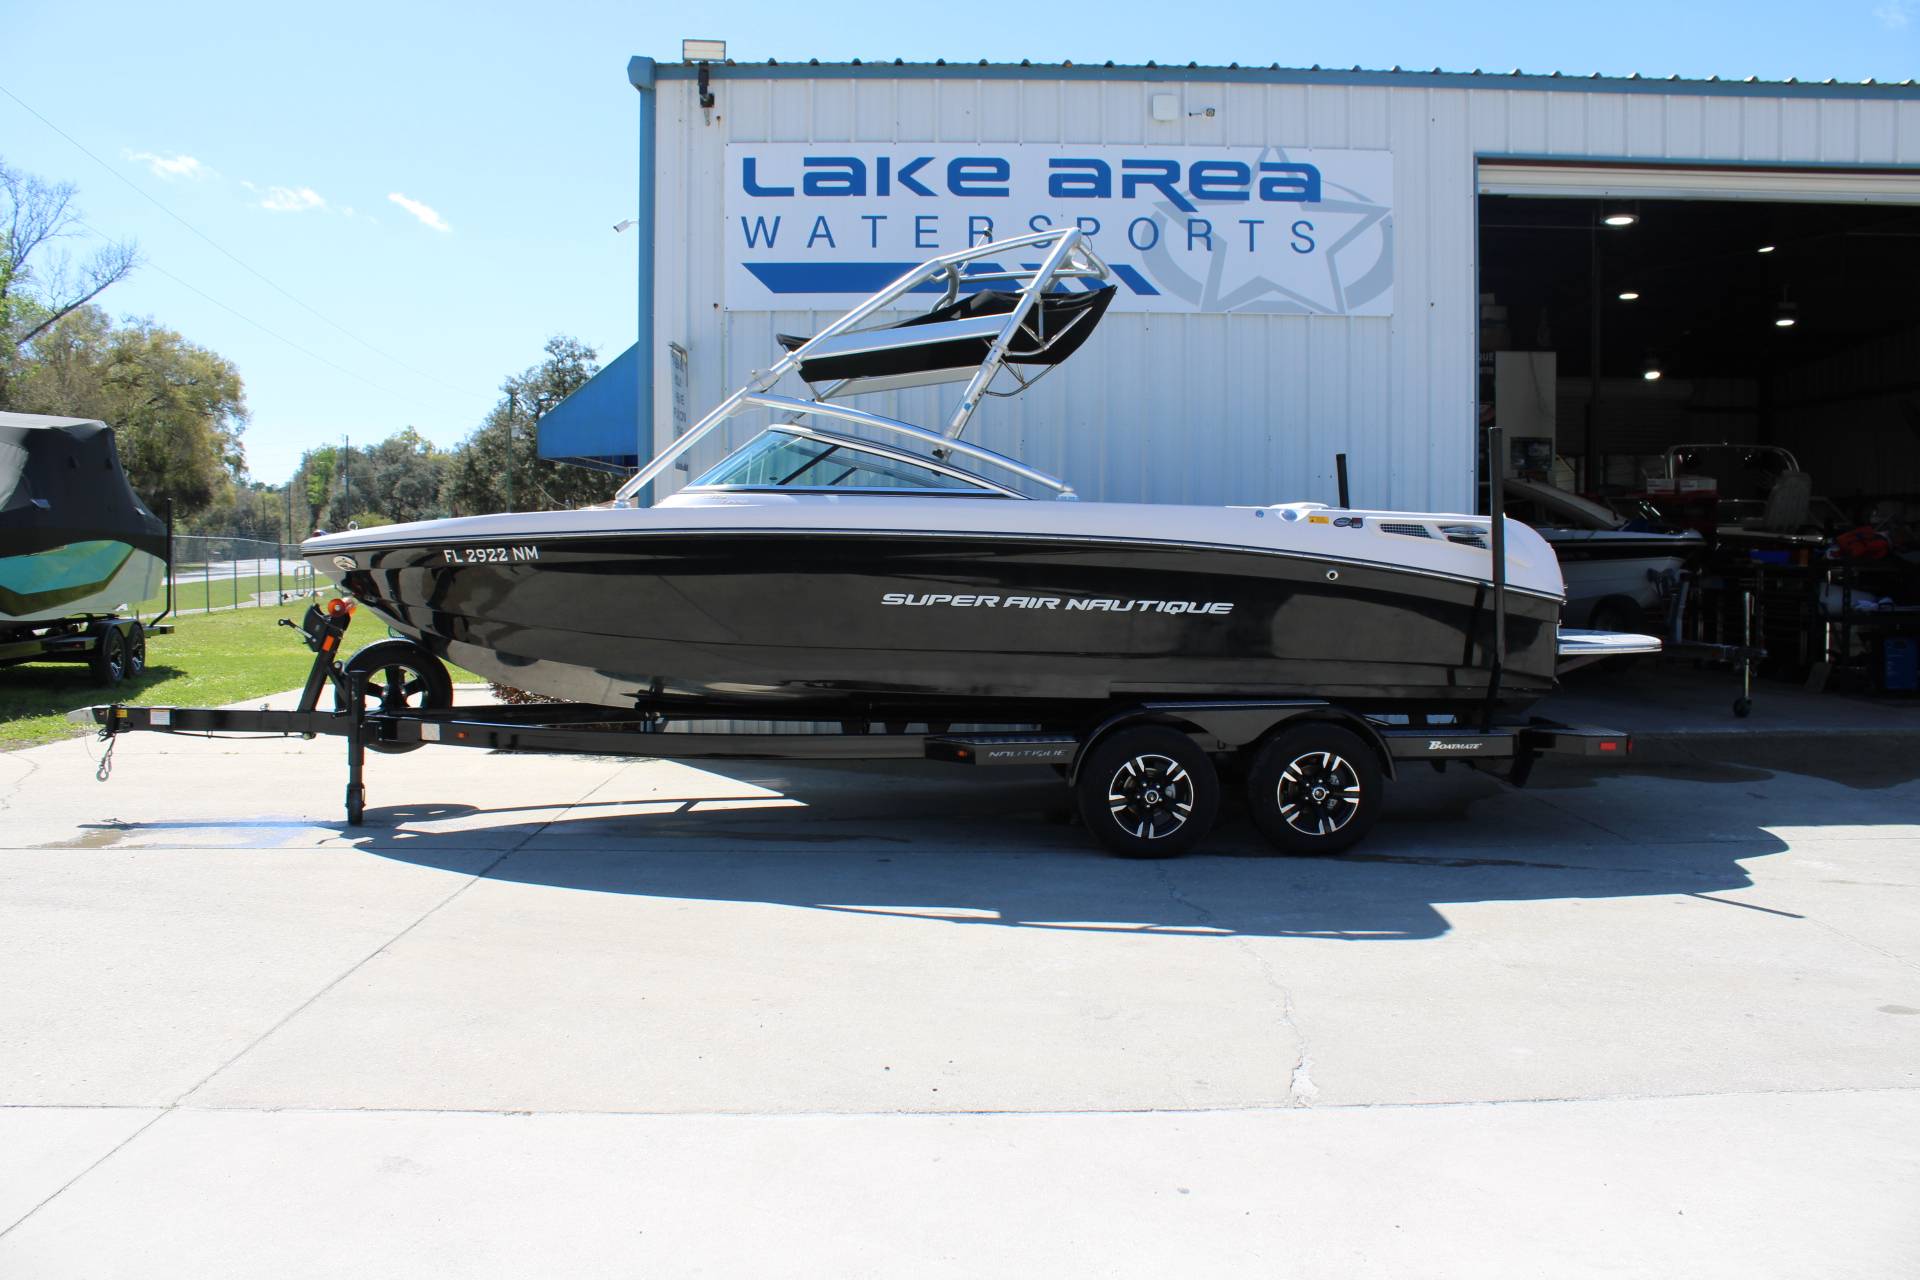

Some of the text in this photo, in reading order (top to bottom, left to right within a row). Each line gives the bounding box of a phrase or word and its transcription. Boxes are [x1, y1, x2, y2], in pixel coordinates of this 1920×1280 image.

[741, 214, 1317, 254] WATERSPORTS
[443, 546, 539, 563] FL 2922 NM
[881, 593, 1235, 615] SUPER AIR NAUTIQUE
[988, 749, 1069, 758] NAUTIQUE
